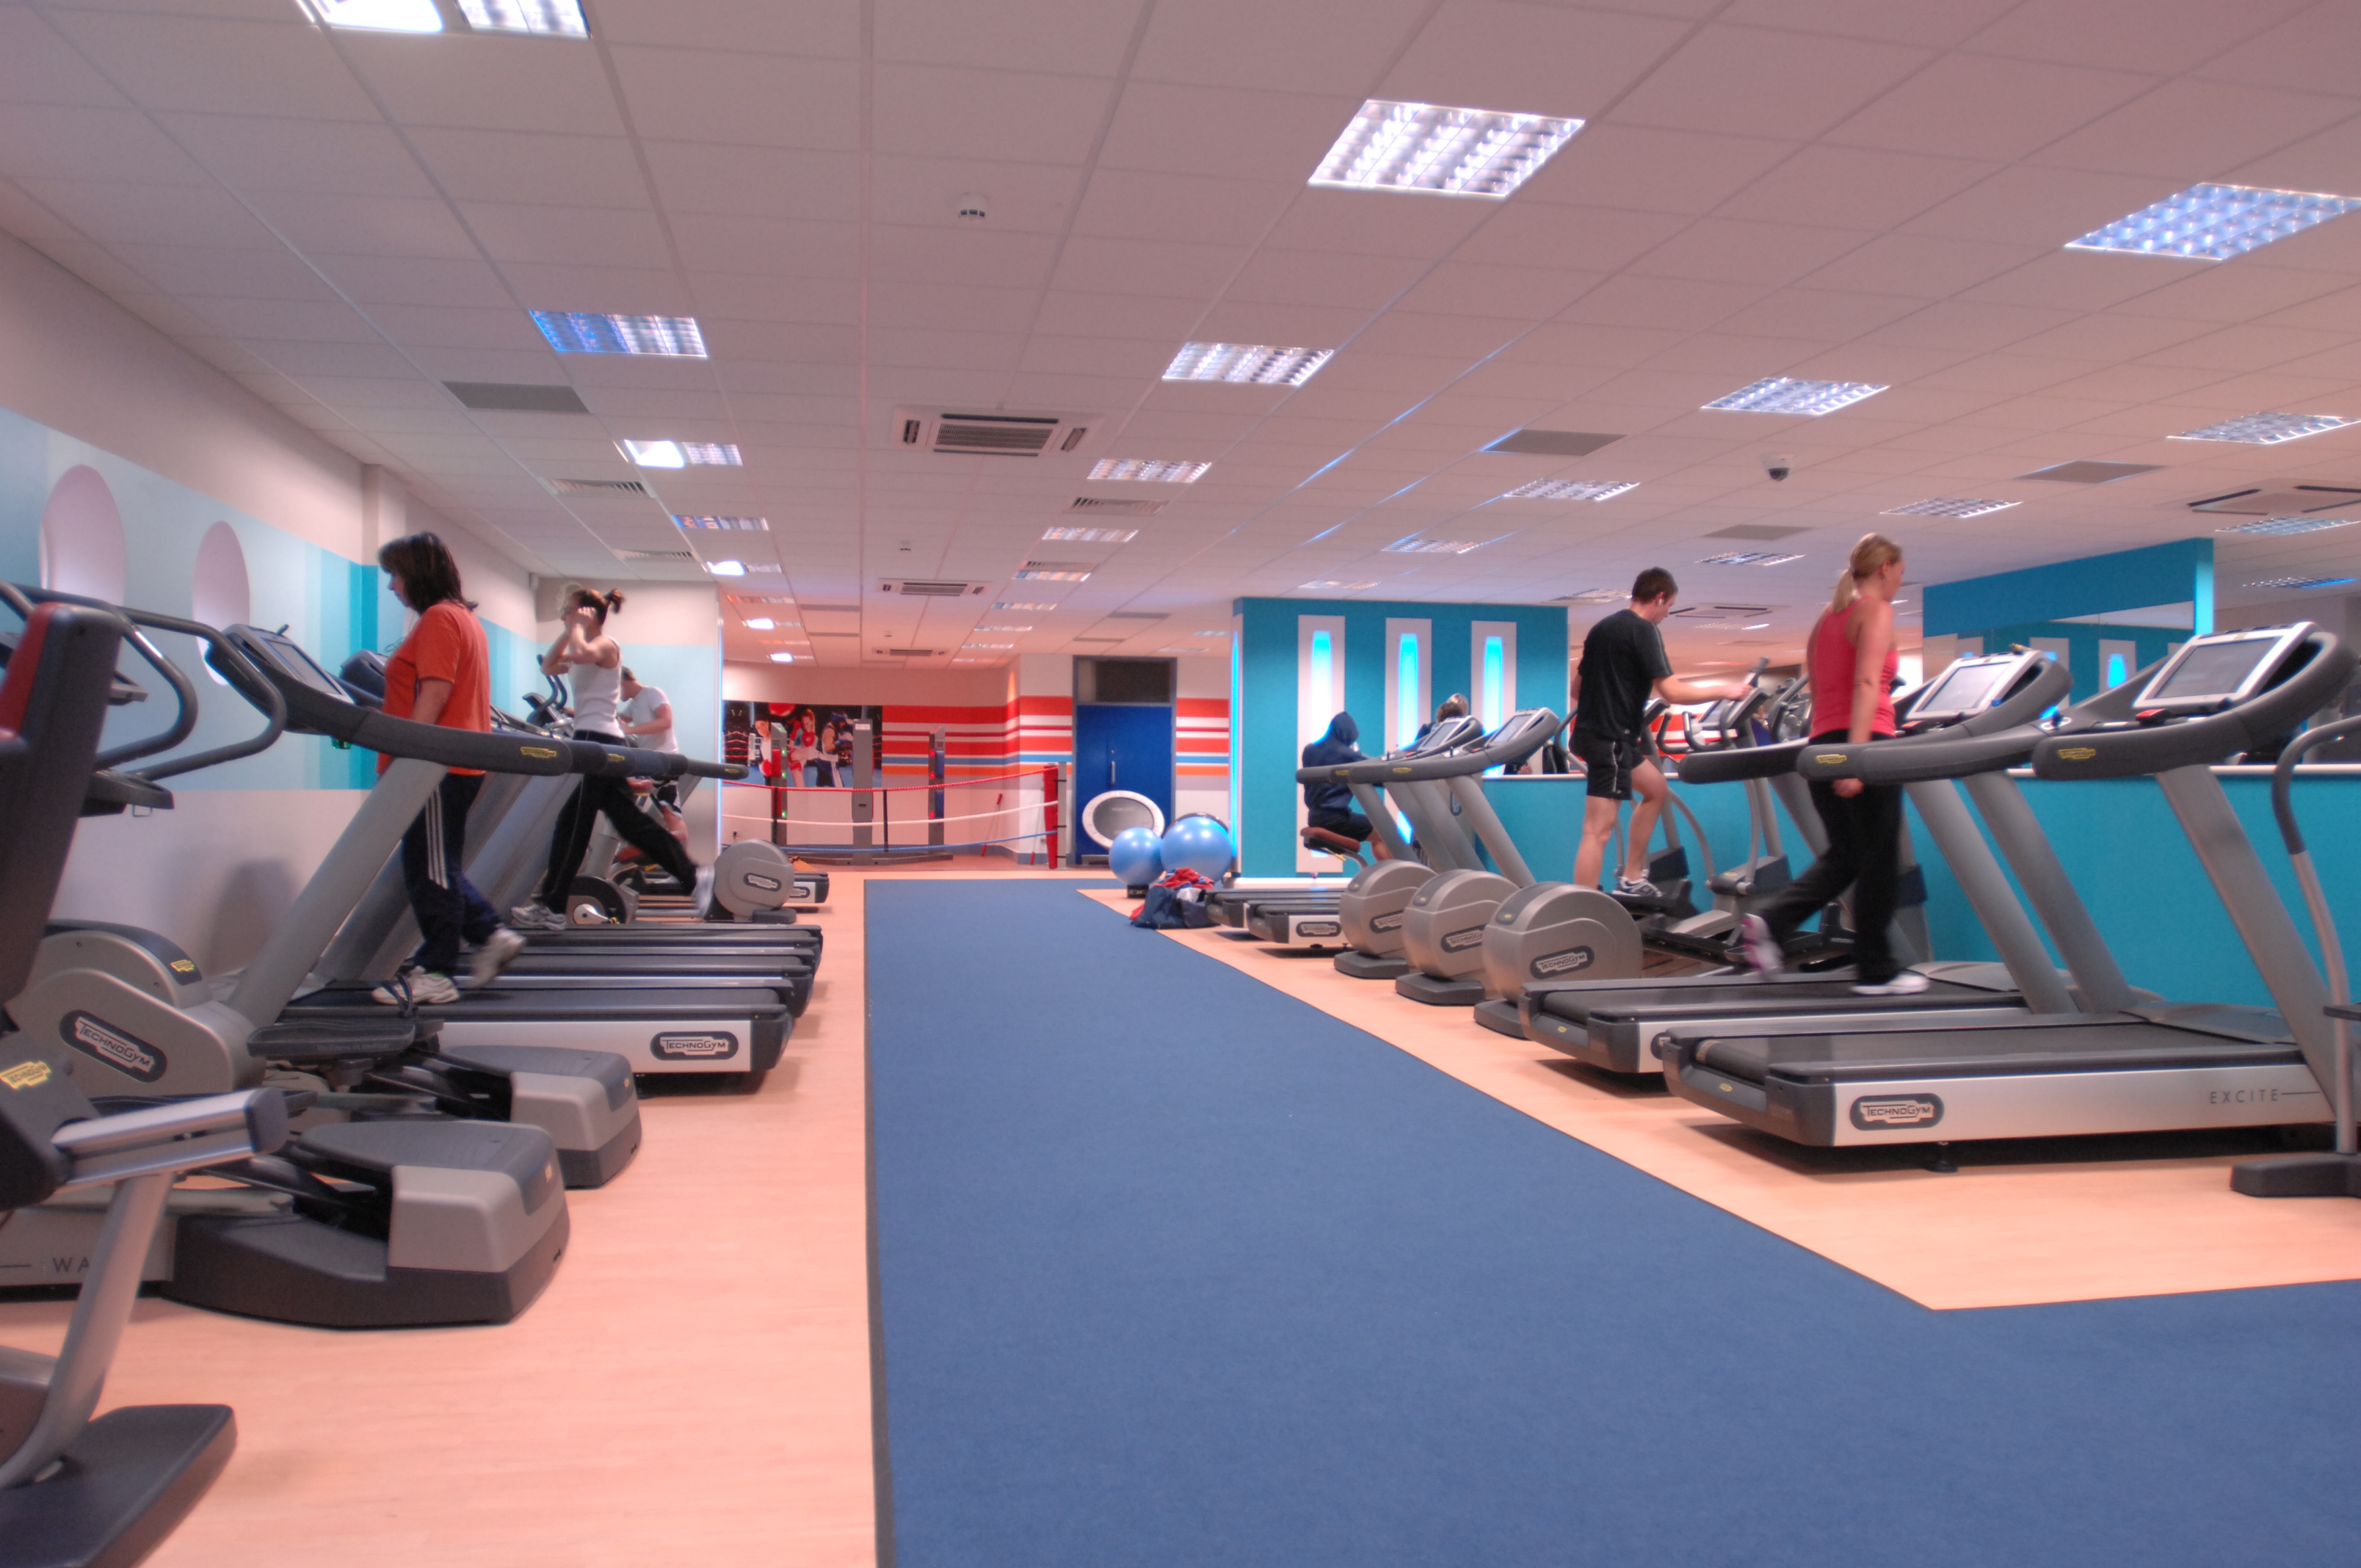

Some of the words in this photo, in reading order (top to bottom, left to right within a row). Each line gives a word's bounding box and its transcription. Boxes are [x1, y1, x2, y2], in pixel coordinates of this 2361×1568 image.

[1538, 954, 1586, 970] TECHNOGYM
[79, 1020, 151, 1067] TECHNOGYM
[661, 1039, 725, 1051] TECHNOGYM
[2211, 1089, 2278, 1104] EXCITE
[1863, 1103, 1932, 1119] TECHNOGYM
